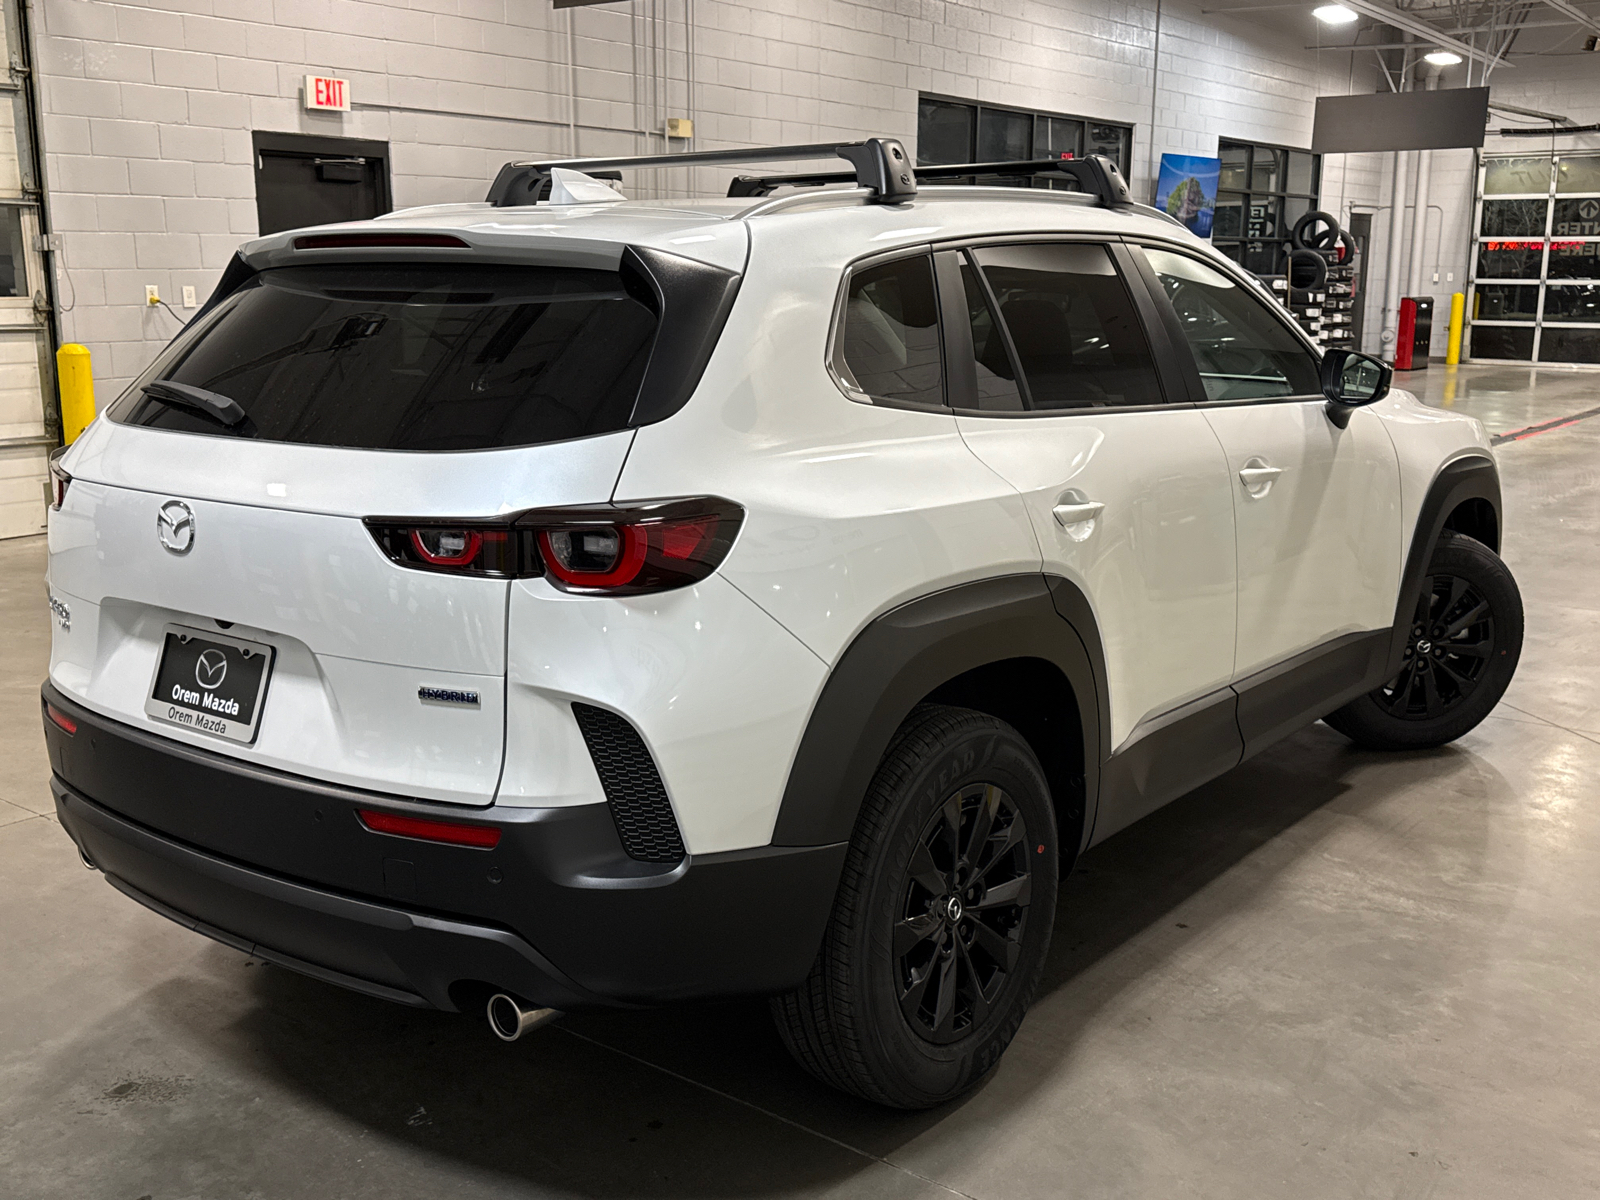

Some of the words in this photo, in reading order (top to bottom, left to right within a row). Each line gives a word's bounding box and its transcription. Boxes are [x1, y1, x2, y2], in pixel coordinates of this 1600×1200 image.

[315, 78, 344, 108] EXIT
[172, 684, 200, 705] Orem
[202, 692, 240, 716] Mazda
[422, 689, 475, 703] HYBRID
[168, 706, 193, 725] Orem
[195, 714, 227, 734] Mazda
